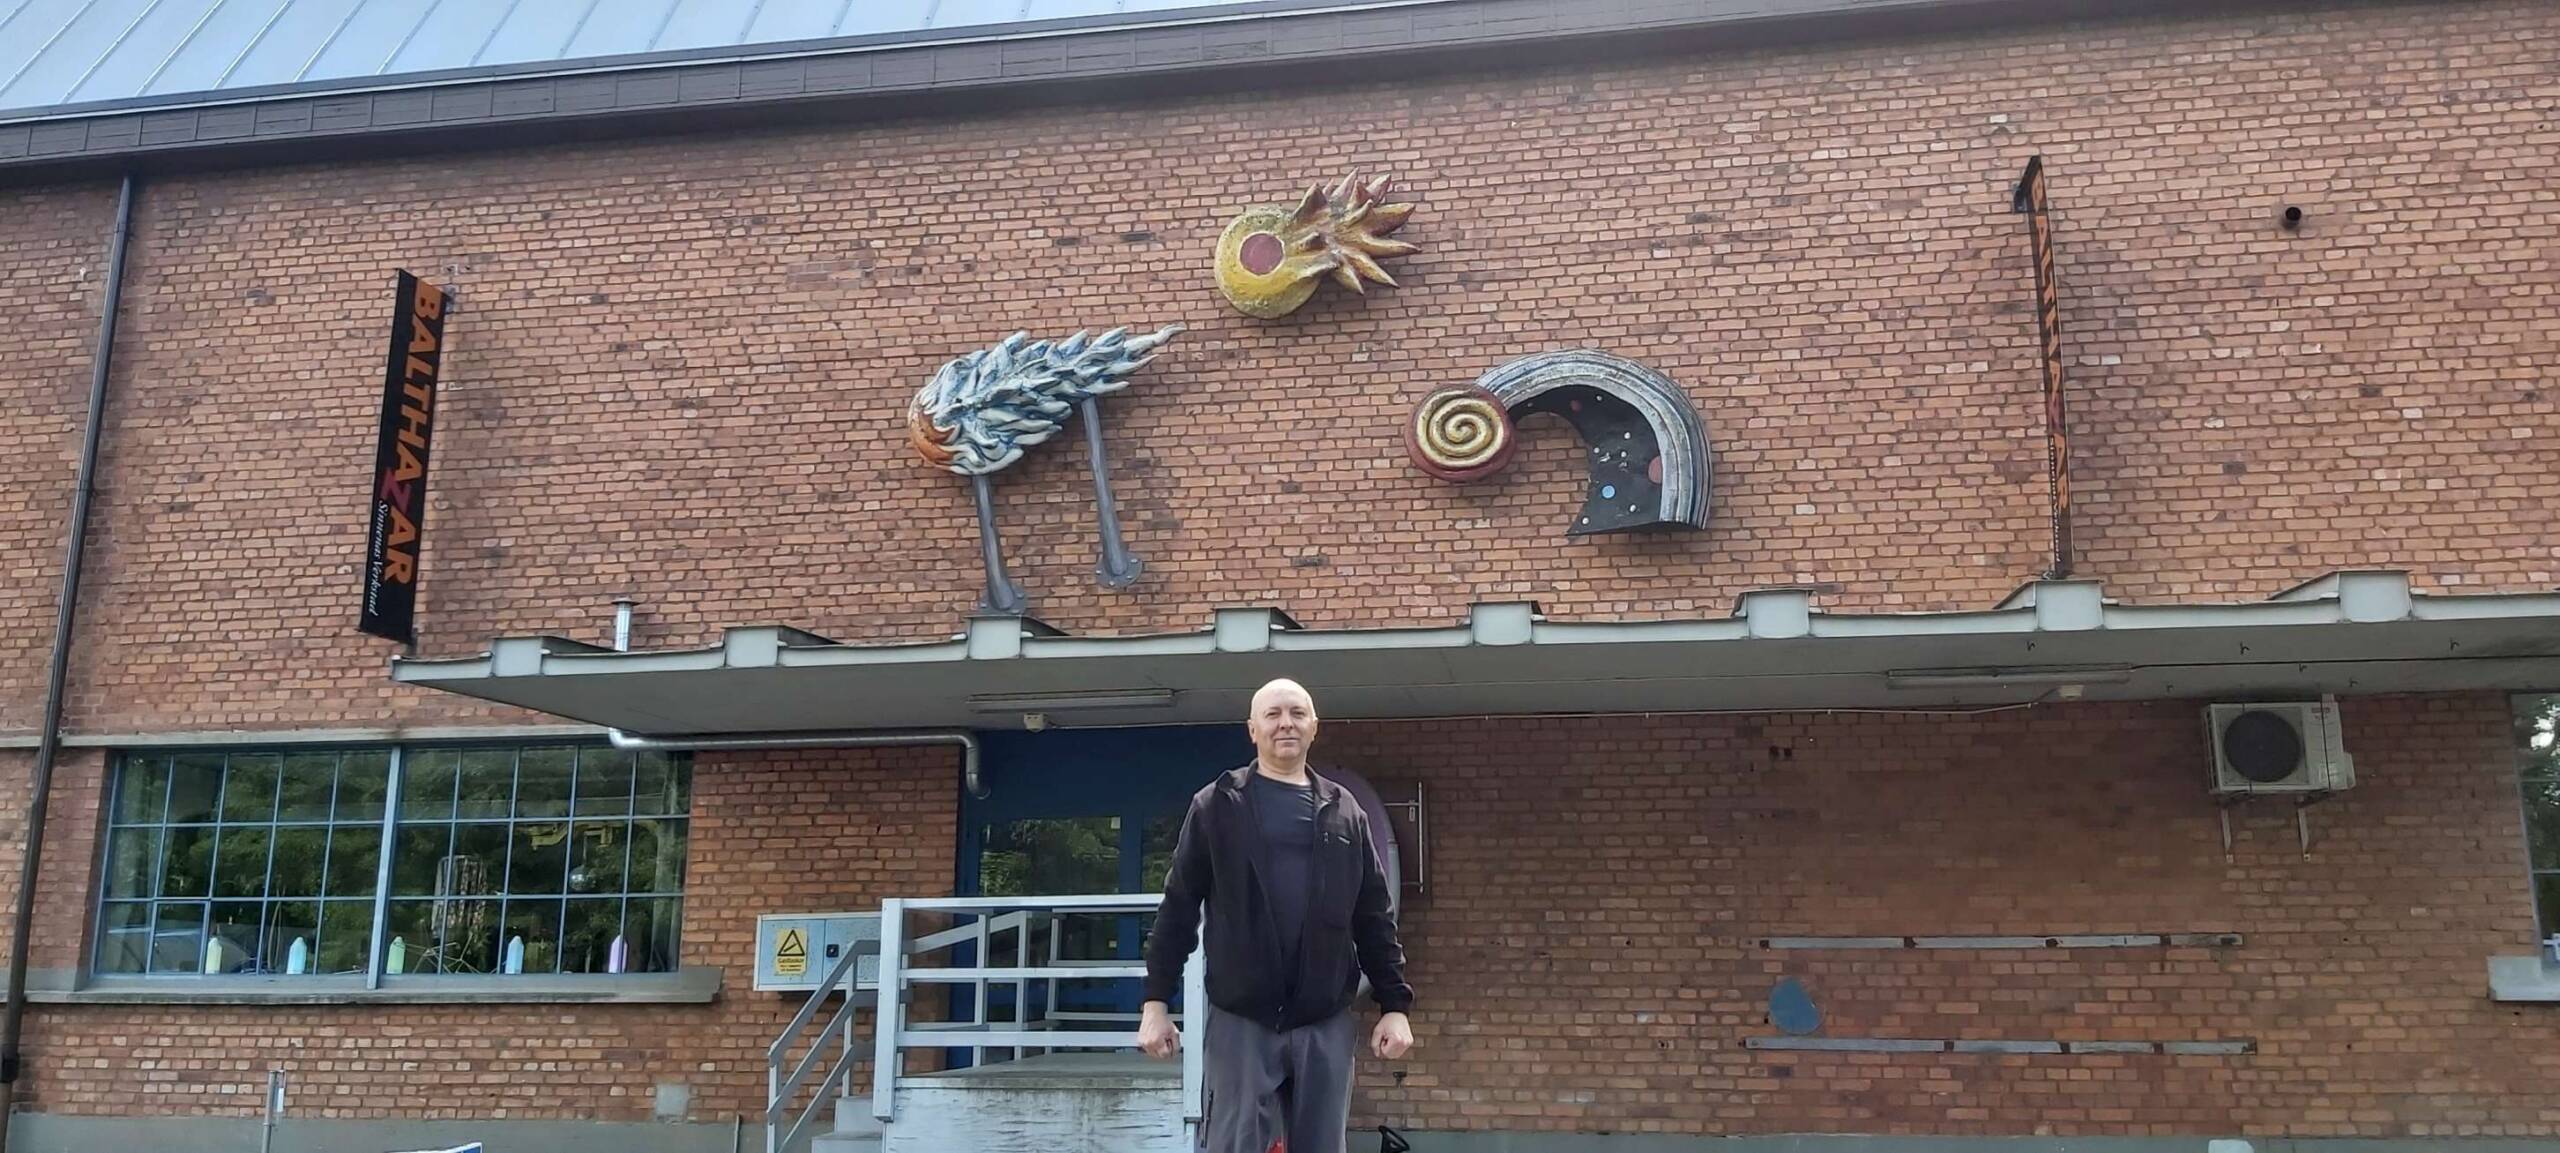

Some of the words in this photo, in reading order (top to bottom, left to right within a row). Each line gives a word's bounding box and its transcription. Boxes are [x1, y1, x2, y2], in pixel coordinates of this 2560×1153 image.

[380, 277, 441, 584] BALTHAZAR
[2032, 170, 2068, 516] BALTHAZAR
[368, 560, 383, 616] Verkstad
[374, 500, 388, 562] Sinnenas
